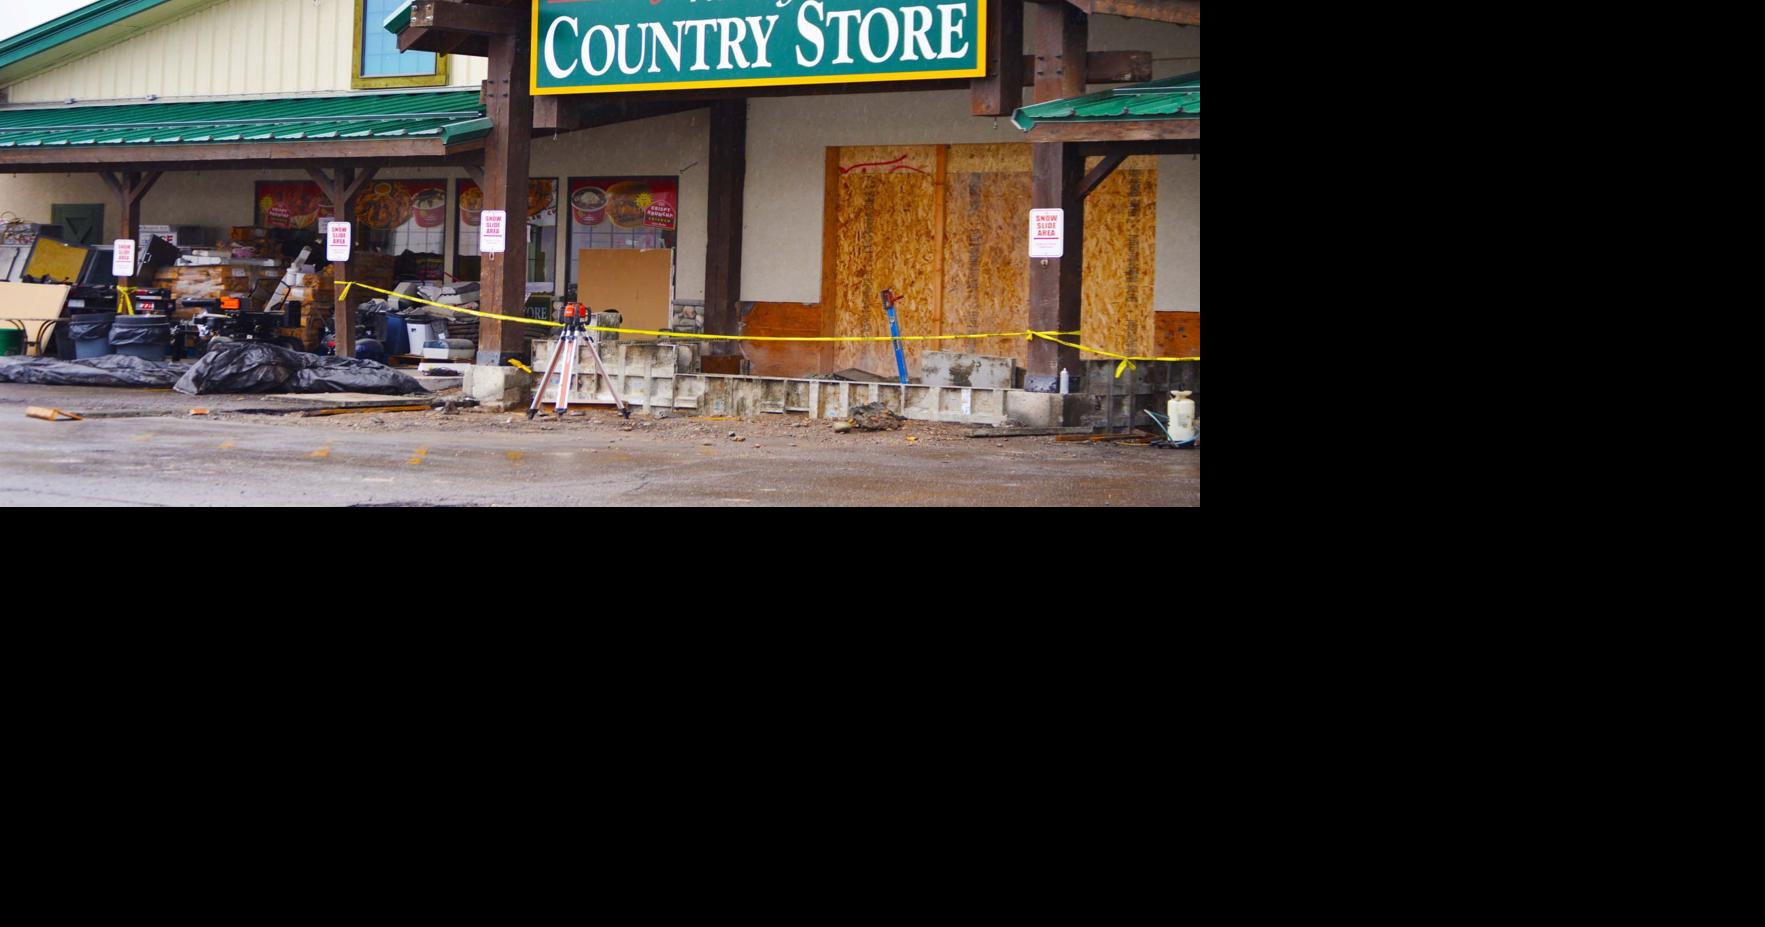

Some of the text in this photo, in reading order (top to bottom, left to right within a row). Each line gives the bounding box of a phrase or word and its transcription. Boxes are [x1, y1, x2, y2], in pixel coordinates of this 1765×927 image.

[544, 1, 969, 79] COUNTRY STORE
[526, 306, 547, 320] ORE
